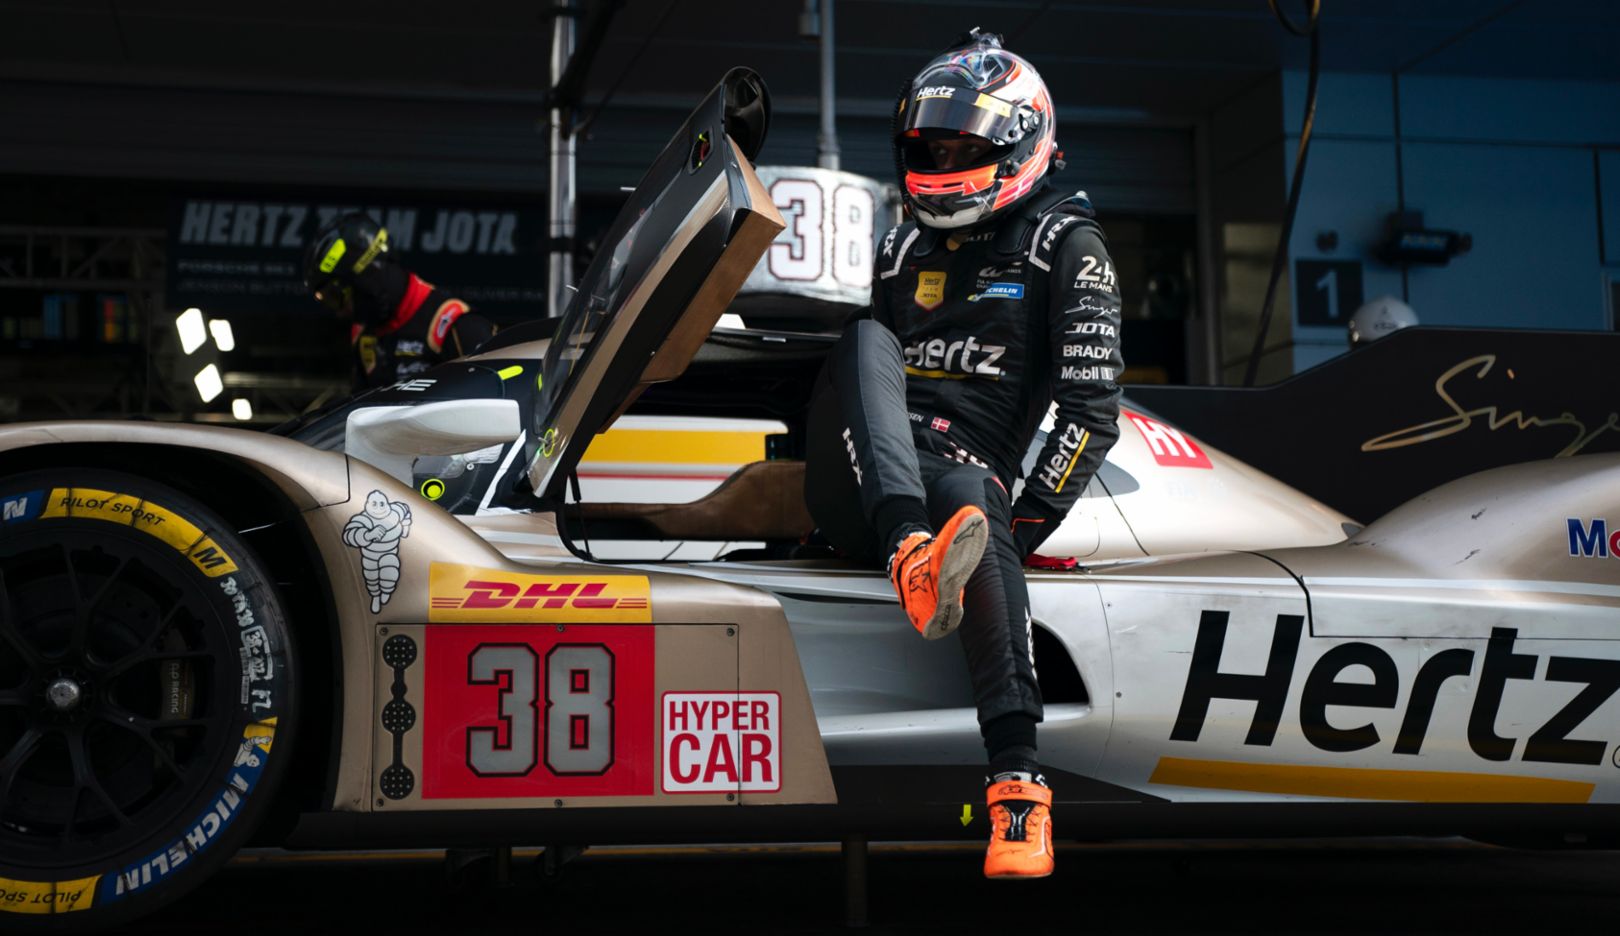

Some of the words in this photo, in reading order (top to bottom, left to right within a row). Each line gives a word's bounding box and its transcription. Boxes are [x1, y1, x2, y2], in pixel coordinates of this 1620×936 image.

[915, 85, 956, 99] Hertz
[180, 202, 307, 247] HERTZ
[316, 206, 417, 251] TM
[421, 210, 518, 255] JOTA
[768, 178, 874, 288] 38
[1073, 281, 1088, 289] LE
[1089, 282, 1112, 293] MANS
[1315, 268, 1340, 319] 1
[1064, 322, 1115, 338] JOTA
[1063, 344, 1113, 360] BRADY
[1061, 366, 1099, 381] Mobil
[1132, 417, 1197, 459] HY
[1038, 422, 1086, 491] Hertz
[60, 496, 109, 509] PILOT
[111, 502, 166, 526] SPORT
[460, 579, 621, 610] DHL
[1169, 609, 1620, 766] Hertz
[465, 641, 616, 778] 38
[668, 700, 770, 731] HYPER
[668, 733, 774, 785] CAR
[115, 772, 249, 896] MICHELIN
[31, 890, 82, 904] PILOT
